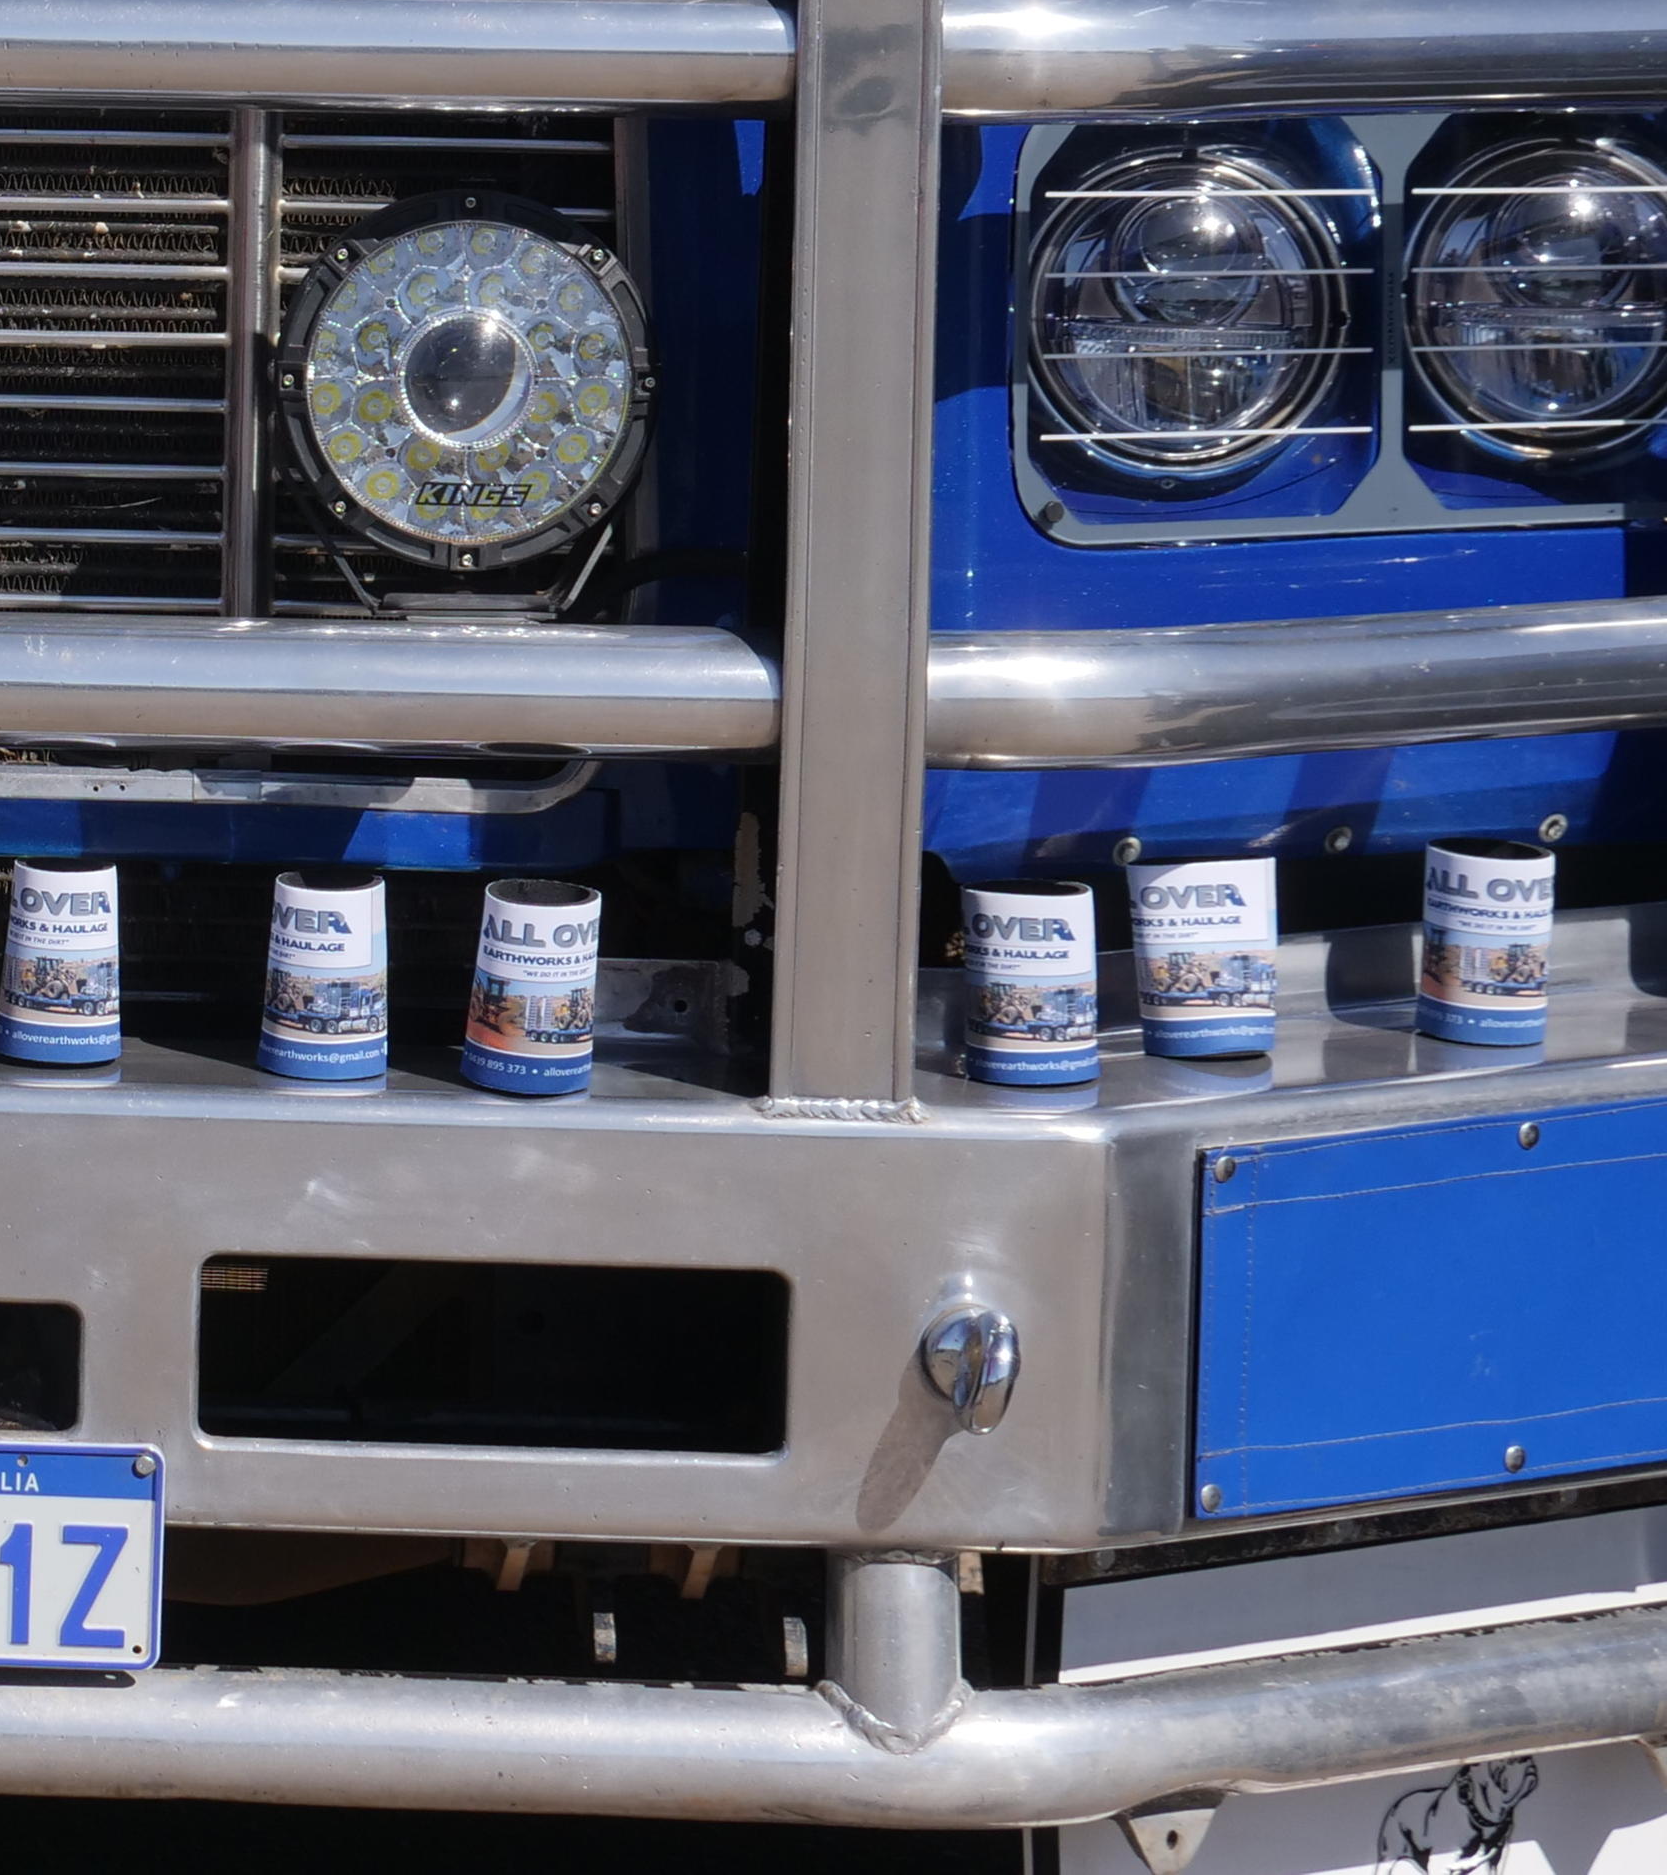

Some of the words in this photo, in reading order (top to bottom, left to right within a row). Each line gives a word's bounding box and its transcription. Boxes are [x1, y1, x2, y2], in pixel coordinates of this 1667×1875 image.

[415, 483, 533, 507] KINGS
[19, 887, 111, 917] OVER
[1140, 883, 1248, 911] OVER
[39, 922, 49, 933] &
[483, 913, 547, 948] ALL
[971, 912, 1077, 942] OVER
[281, 935, 346, 953] HAULAGE
[483, 944, 573, 966] EARTHWORKS
[1003, 949, 1071, 960] HAULAGE
[487, 1058, 505, 1072] 895
[506, 1063, 527, 1076] 373
